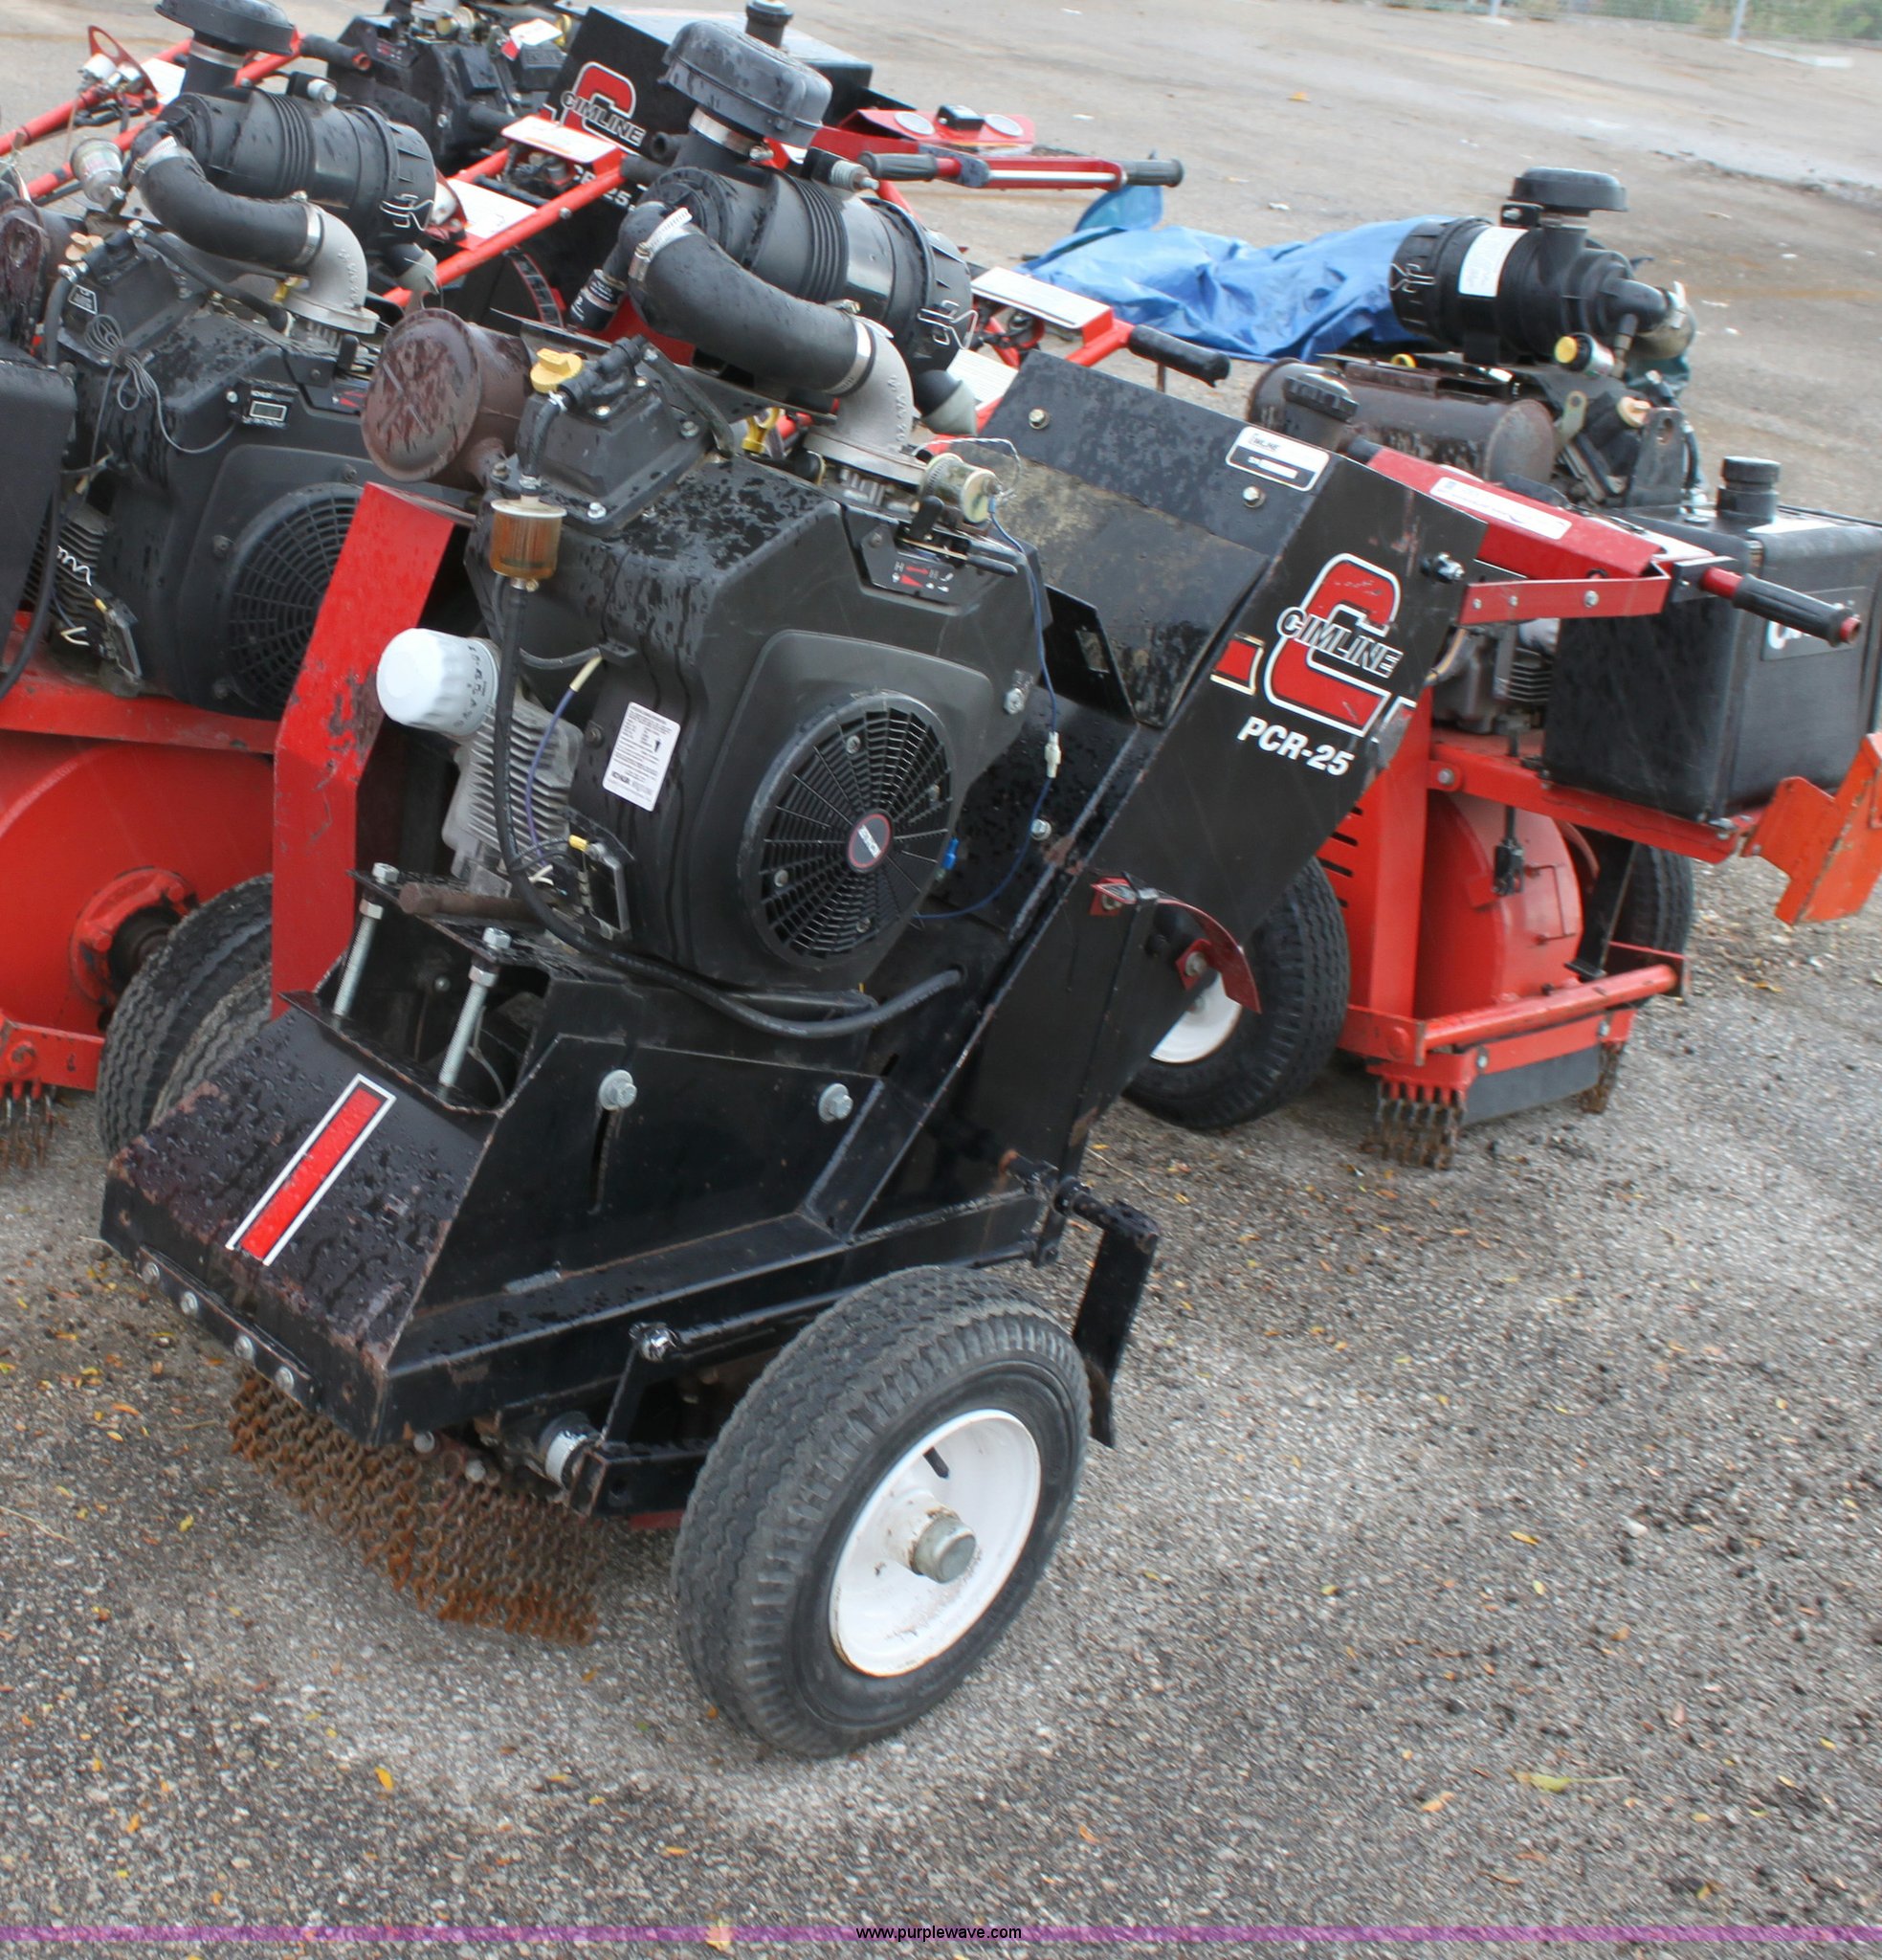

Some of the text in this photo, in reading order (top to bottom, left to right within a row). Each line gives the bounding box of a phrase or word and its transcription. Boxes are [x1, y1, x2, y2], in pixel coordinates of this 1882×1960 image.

[560, 91, 647, 146] CIMLINE
[1276, 606, 1405, 679] CIMLINE
[1237, 716, 1355, 776] PCR-25
